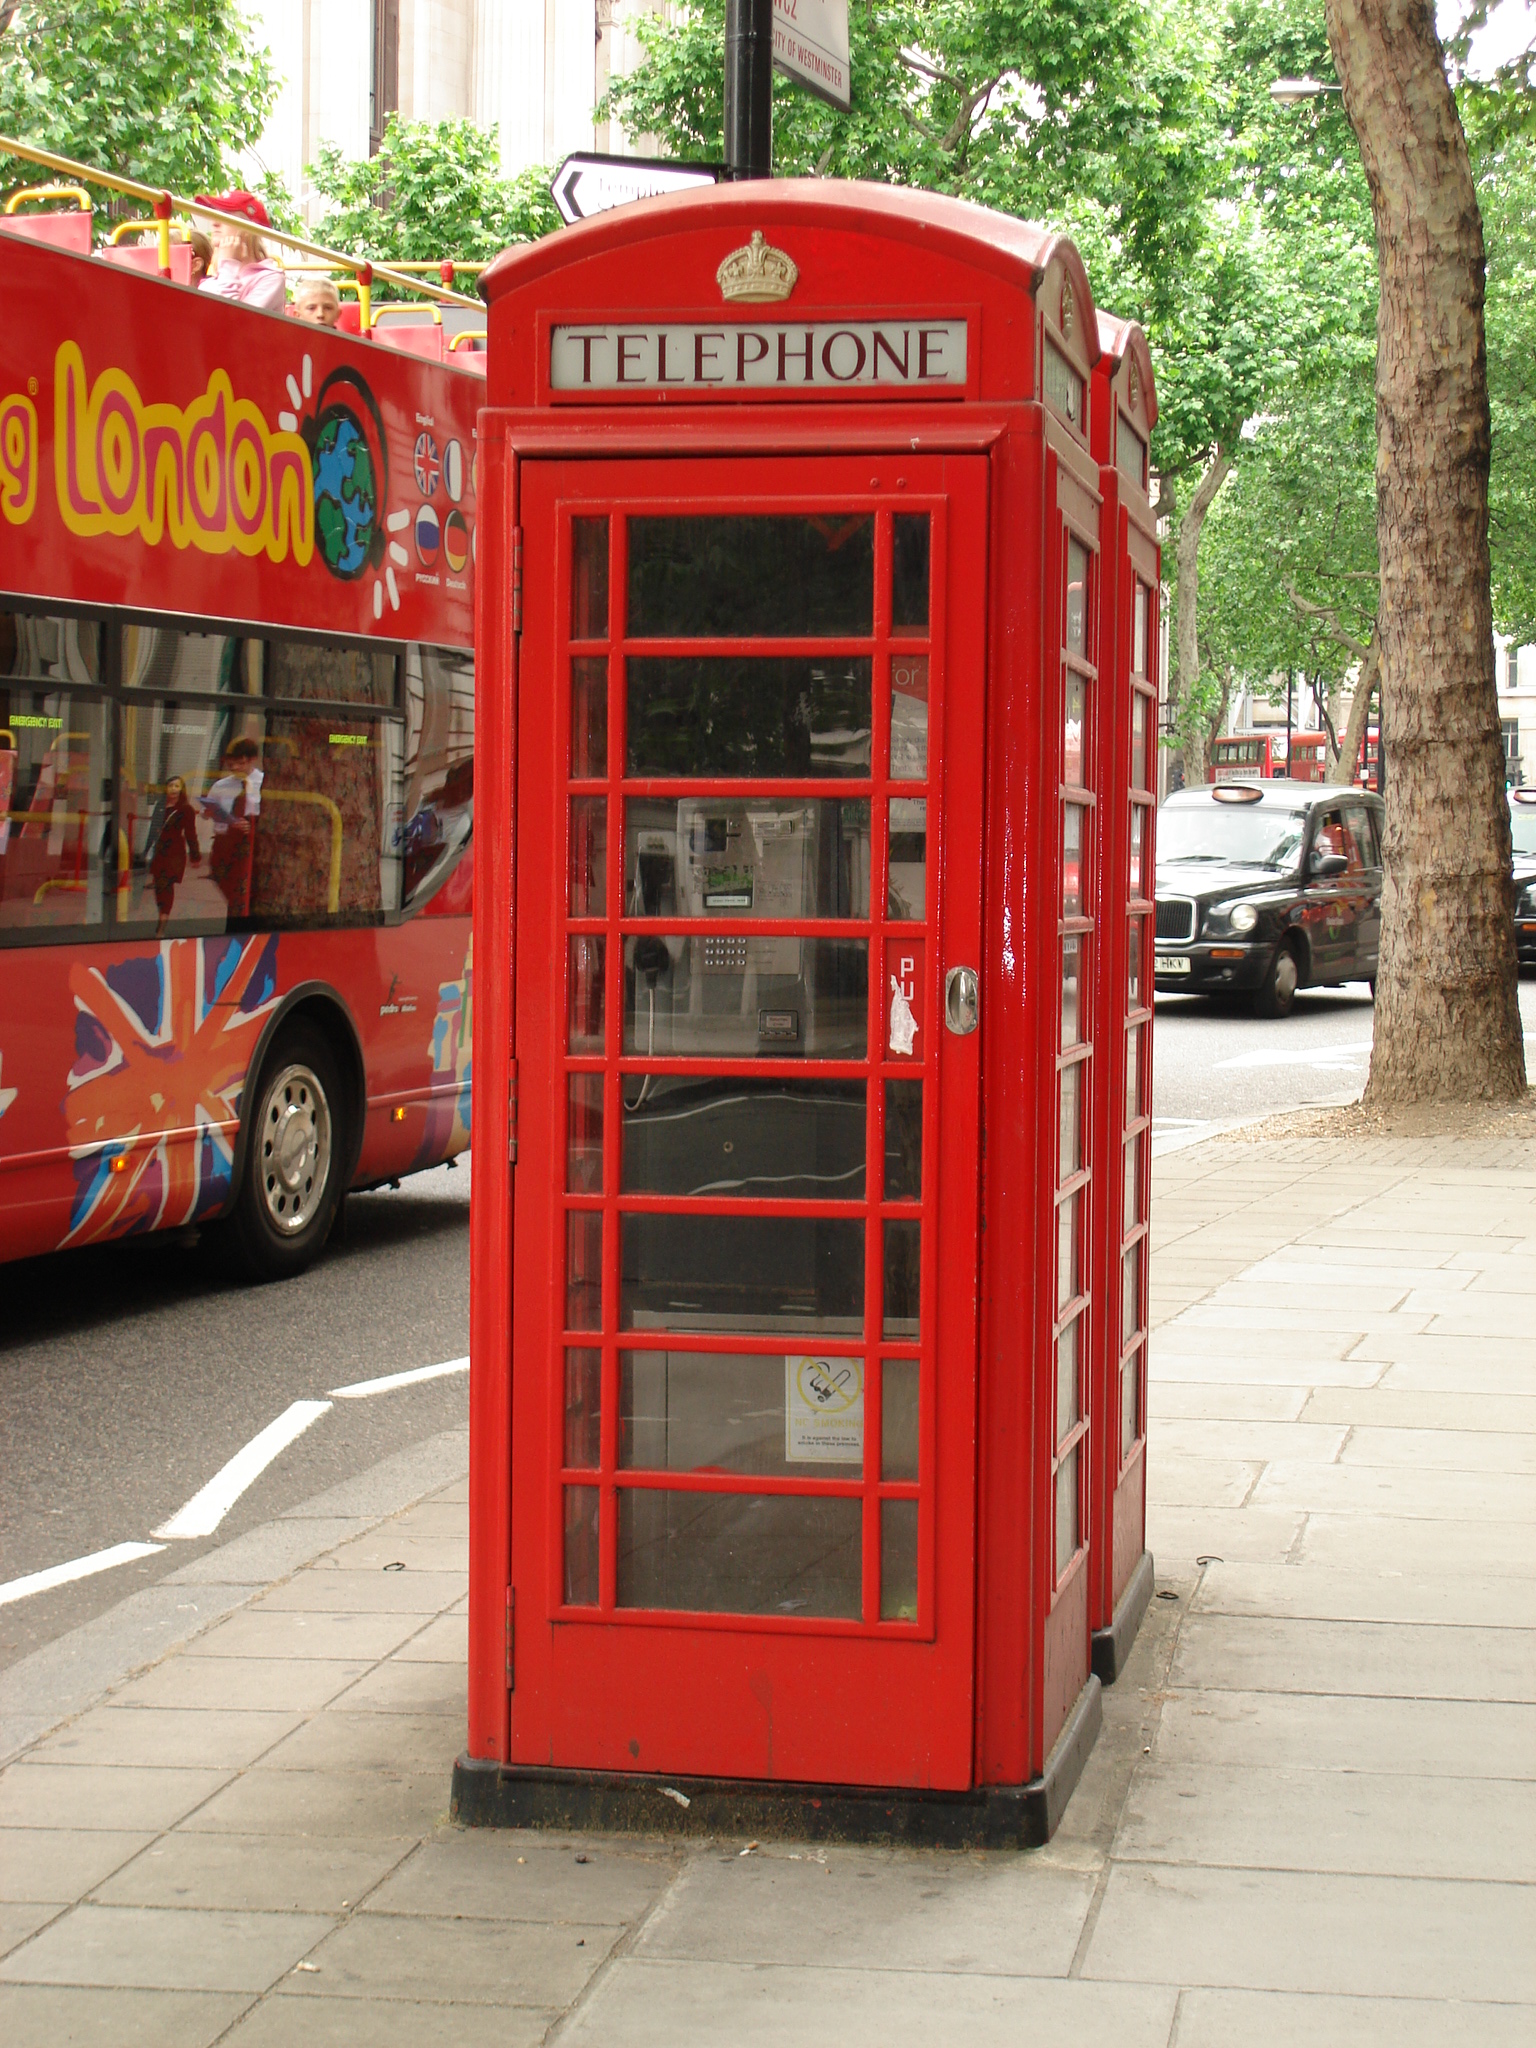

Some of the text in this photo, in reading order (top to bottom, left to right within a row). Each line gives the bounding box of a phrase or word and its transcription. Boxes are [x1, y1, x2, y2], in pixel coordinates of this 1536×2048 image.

[787, 38, 797, 58] OF
[797, 44, 843, 89] WESTMINSTER
[567, 328, 950, 383] TELEPHONE
[54, 340, 316, 567] London
[9, 714, 63, 729] EMERGENCY EXIT
[328, 733, 356, 744] EMERGENCY
[1161, 958, 1184, 969] HKV
